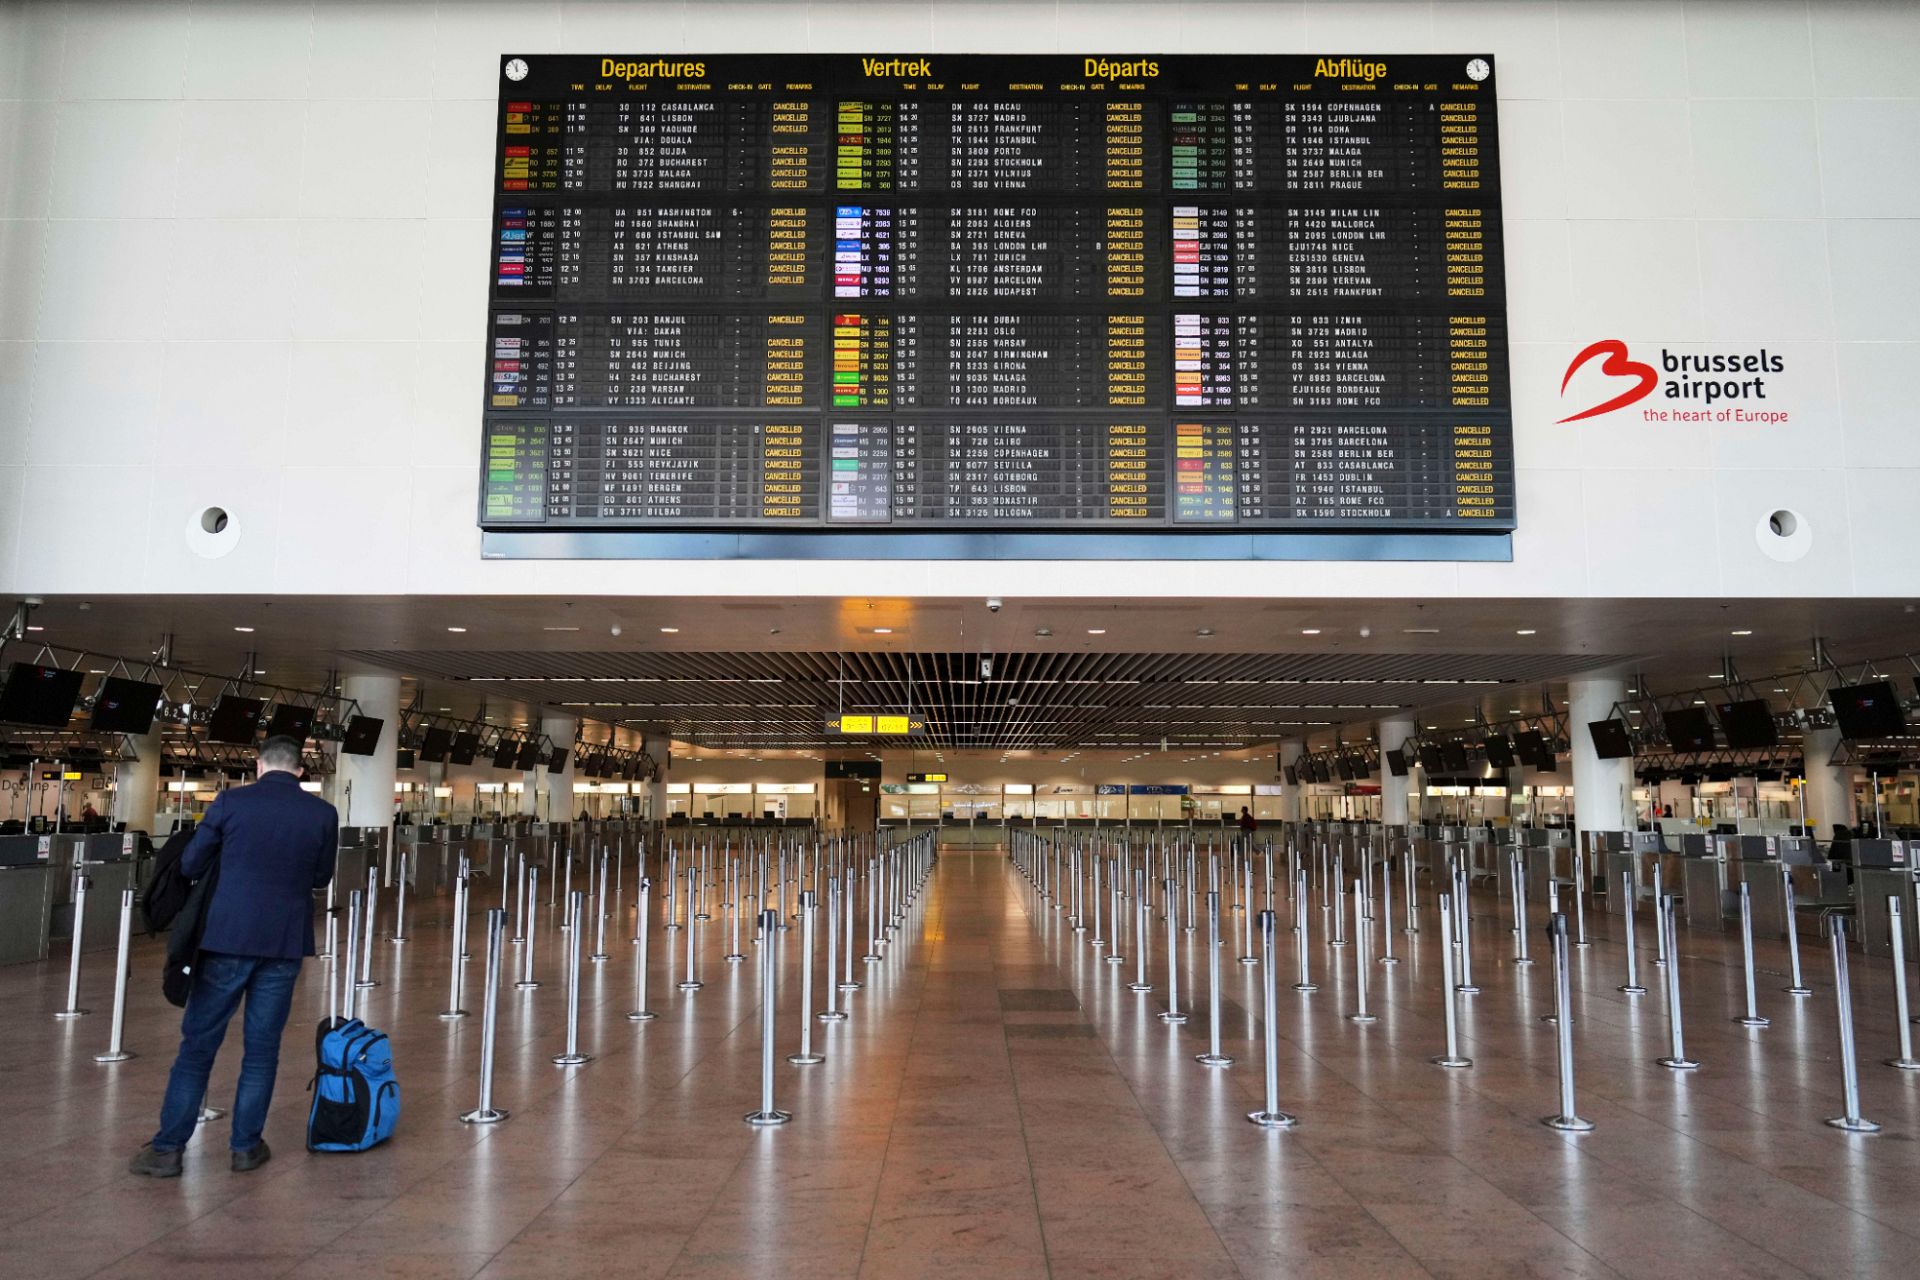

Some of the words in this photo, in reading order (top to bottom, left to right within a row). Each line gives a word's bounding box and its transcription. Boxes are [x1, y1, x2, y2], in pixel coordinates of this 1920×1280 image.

[601, 59, 705, 80] Departures
[862, 59, 931, 76] Vertrek
[1084, 59, 1159, 80] Départs
[1314, 60, 1387, 81] Abflüge
[662, 104, 714, 112] CASABLANCA
[1328, 104, 1382, 112] COPENHAGEN
[662, 114, 692, 122] LISBON
[994, 114, 1026, 122] MADRID
[1106, 114, 1142, 122] CANCELLED
[1328, 114, 1376, 122] LJUBLJANA
[994, 125, 1042, 133] FRANKFURT
[660, 136, 692, 144] DOUALA
[996, 136, 1036, 144] ISTANBUL
[1330, 136, 1370, 144] ISTANBUL
[994, 148, 1020, 156] PORTO
[1328, 148, 1362, 156] MALAGA
[660, 158, 708, 166] BUCHAREST
[772, 158, 808, 166] CANCELLED
[994, 158, 1042, 166] STOCKHOLM
[1330, 158, 1362, 166] MUNICH
[1442, 159, 1479, 167] CANCELLED
[658, 170, 690, 178] MALAGA
[994, 170, 1032, 178] VILNIUS
[1330, 170, 1362, 178] BERLIN
[1368, 170, 1384, 178] BER
[658, 180, 700, 188] SHANGHAI
[994, 180, 1026, 188] VIENNA
[1330, 180, 1362, 188] PRAGUE
[994, 208, 1014, 216] ROME
[1020, 208, 1036, 216] FCO
[1330, 209, 1358, 217] MILAN
[1364, 209, 1380, 217] LIN
[658, 220, 698, 228] SHANGHAI
[770, 220, 807, 228] CANCELLED
[994, 220, 1030, 228] ALGIERS
[1106, 220, 1144, 228] CANCELLED
[1332, 220, 1374, 228] MALLORCA
[1444, 220, 1482, 228] CANCELLED
[658, 231, 700, 239] ISTANBUL
[994, 230, 1026, 238] GENEVA
[1332, 232, 1364, 240] LONDON
[1370, 232, 1386, 240] LHR
[656, 242, 688, 250] ATHENS
[994, 242, 1026, 250] LONDON
[1032, 242, 1046, 250] LHR
[1332, 242, 1354, 250] NICE
[1332, 254, 1364, 262] GENEVA
[768, 264, 806, 273] CANCELLED
[994, 265, 1042, 273] AMSTERDAM
[1106, 264, 1145, 273] CANCELLED
[1334, 266, 1366, 274] LISBON
[656, 276, 704, 284] BARCELONA
[994, 276, 1042, 284] BARCELONA
[1334, 276, 1370, 284] YEREVAN
[994, 288, 1036, 296] BUDAPEST
[1334, 288, 1382, 296] FRANKFURT
[994, 316, 1020, 324] DUBAI
[654, 327, 680, 335] DAKAR
[994, 328, 1016, 336] OSLO
[1108, 328, 1145, 336] CANCELLED
[1334, 328, 1368, 336] MADRID
[1450, 328, 1488, 336] CANCELLED
[654, 339, 680, 347] TUNIS
[994, 340, 1026, 348] WARSAW
[1334, 340, 1374, 348] ANTALYA
[652, 350, 686, 358] MUNICH
[994, 350, 1048, 358] BIRMINGHAM
[1334, 350, 1368, 358] MALAGA
[1662, 349, 1784, 373] brussels
[652, 362, 690, 370] BEIJING
[1336, 362, 1368, 370] VIENNA
[652, 374, 700, 382] BUCHAREST
[768, 374, 804, 382] CANCELLED
[992, 374, 1026, 382] MALAGA
[1108, 374, 1145, 382] CANCELLED
[1336, 374, 1386, 382] BARCELONA
[1452, 374, 1488, 382] CANCELLED
[652, 385, 684, 393] WARSAW
[994, 386, 1026, 394] MADRID
[1336, 386, 1380, 394] BORDEAUX
[1664, 374, 1766, 404] airport
[652, 396, 694, 404] ALICANTE
[994, 396, 1036, 404] BORDEAUX
[1336, 398, 1358, 406] ROME
[1364, 398, 1380, 406] FCO
[1643, 409, 1668, 422] the
[1673, 409, 1711, 422] heart
[1716, 409, 1731, 422] of
[1735, 409, 1788, 424] Europe
[650, 426, 688, 434] BANGKOK
[994, 426, 1026, 434] VIENNA
[1338, 426, 1388, 434] BARCELONA
[650, 436, 682, 444] MUNICH
[764, 438, 803, 446] CANCELLED
[994, 438, 1020, 446] CAIRO
[1108, 438, 1147, 446] CANCELLED
[1338, 438, 1388, 446] BARCELONA
[1456, 438, 1492, 446] CANCELLED
[650, 448, 672, 456] NICE
[994, 450, 1048, 458] COPENHAGEN
[1338, 450, 1372, 458] BERLIN
[1378, 450, 1394, 458] BER
[650, 460, 698, 468] REYKJAVIK
[994, 462, 1032, 470] SEVILLA
[1338, 462, 1394, 470] CASABLANCA
[650, 472, 692, 480] TENERIFE
[1340, 474, 1372, 482] DUBLIN
[648, 484, 682, 492] BERGEN
[764, 484, 801, 493] CANCELLED
[994, 484, 1026, 492] LISBON
[1340, 486, 1384, 494] ISTANBUL
[648, 496, 680, 504] ATHENS
[1340, 496, 1362, 504] ROME
[1368, 496, 1384, 504] FCO
[648, 508, 680, 516] BILBAO
[994, 508, 1032, 516] BOLOGNA
[1340, 508, 1390, 516] STOCKHOLM
